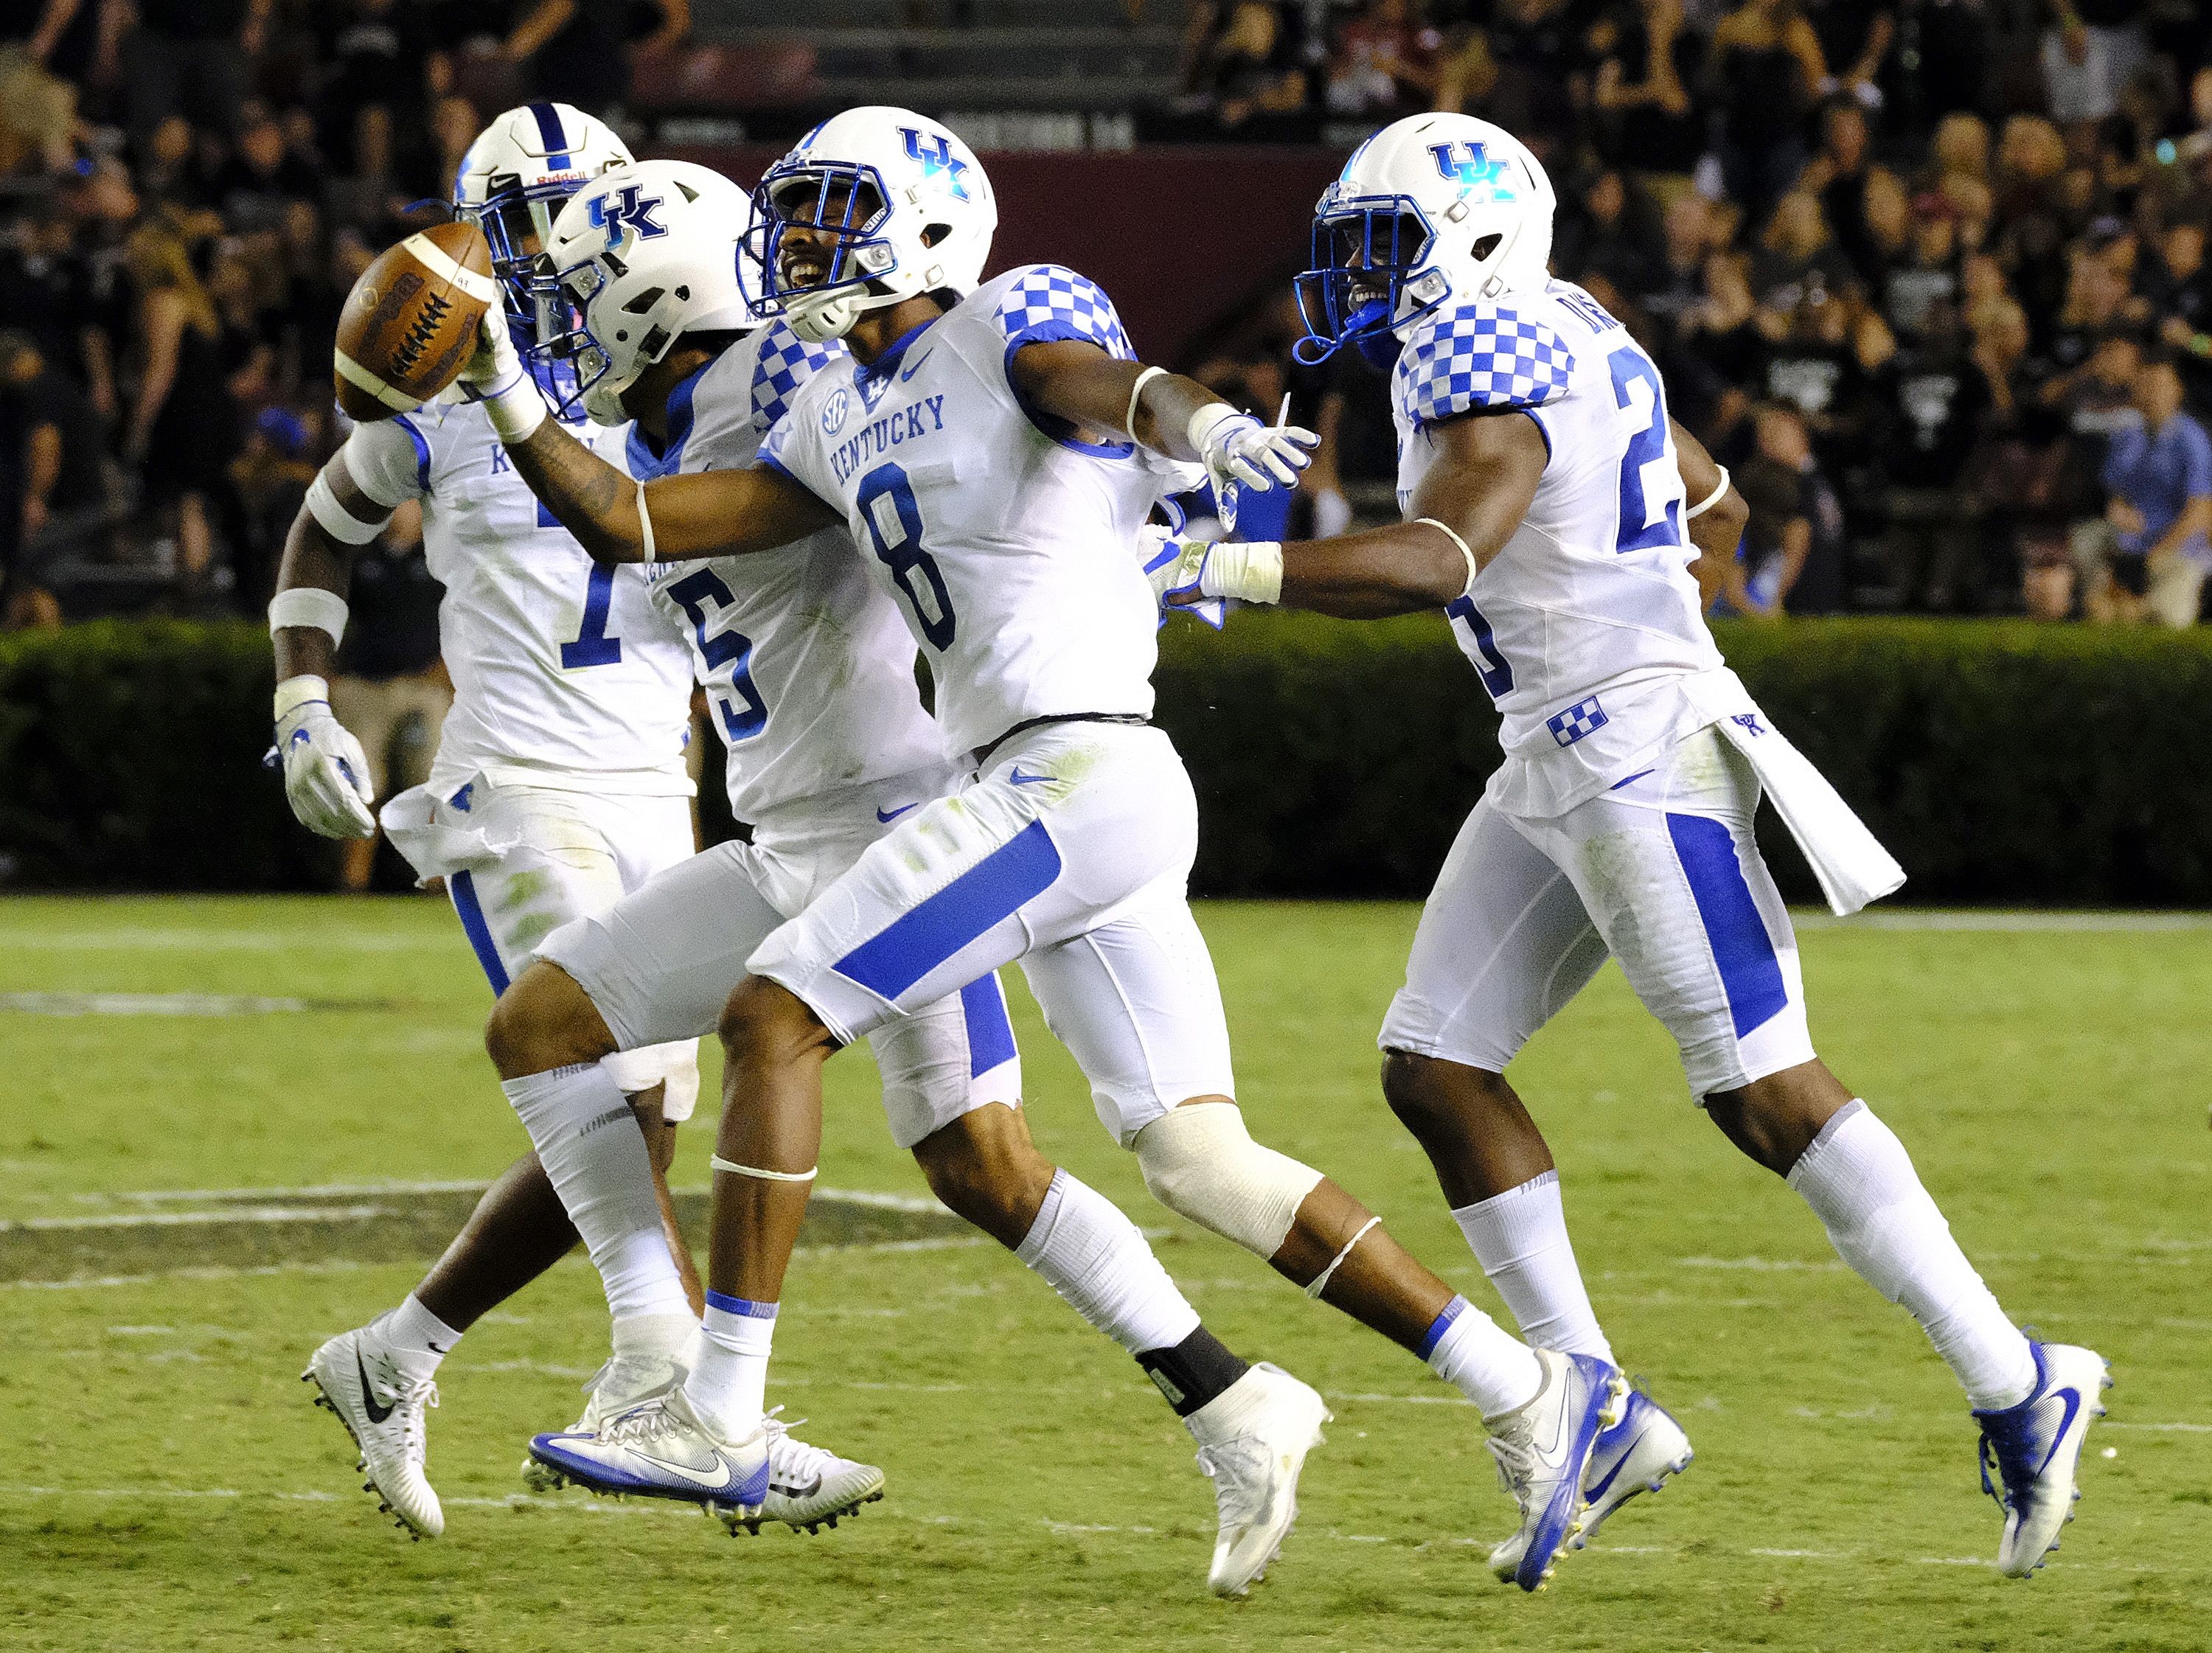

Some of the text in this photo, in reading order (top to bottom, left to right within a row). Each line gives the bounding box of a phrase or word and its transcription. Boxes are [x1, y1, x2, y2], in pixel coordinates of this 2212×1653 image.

[537, 170, 586, 185] Riddell
[896, 125, 970, 203] UK
[1426, 139, 1517, 203] UK
[585, 184, 668, 252] UK
[824, 389, 846, 433] SEC
[830, 394, 944, 488] KENTUCKY
[856, 462, 956, 652] 8
[666, 567, 769, 742] 5
